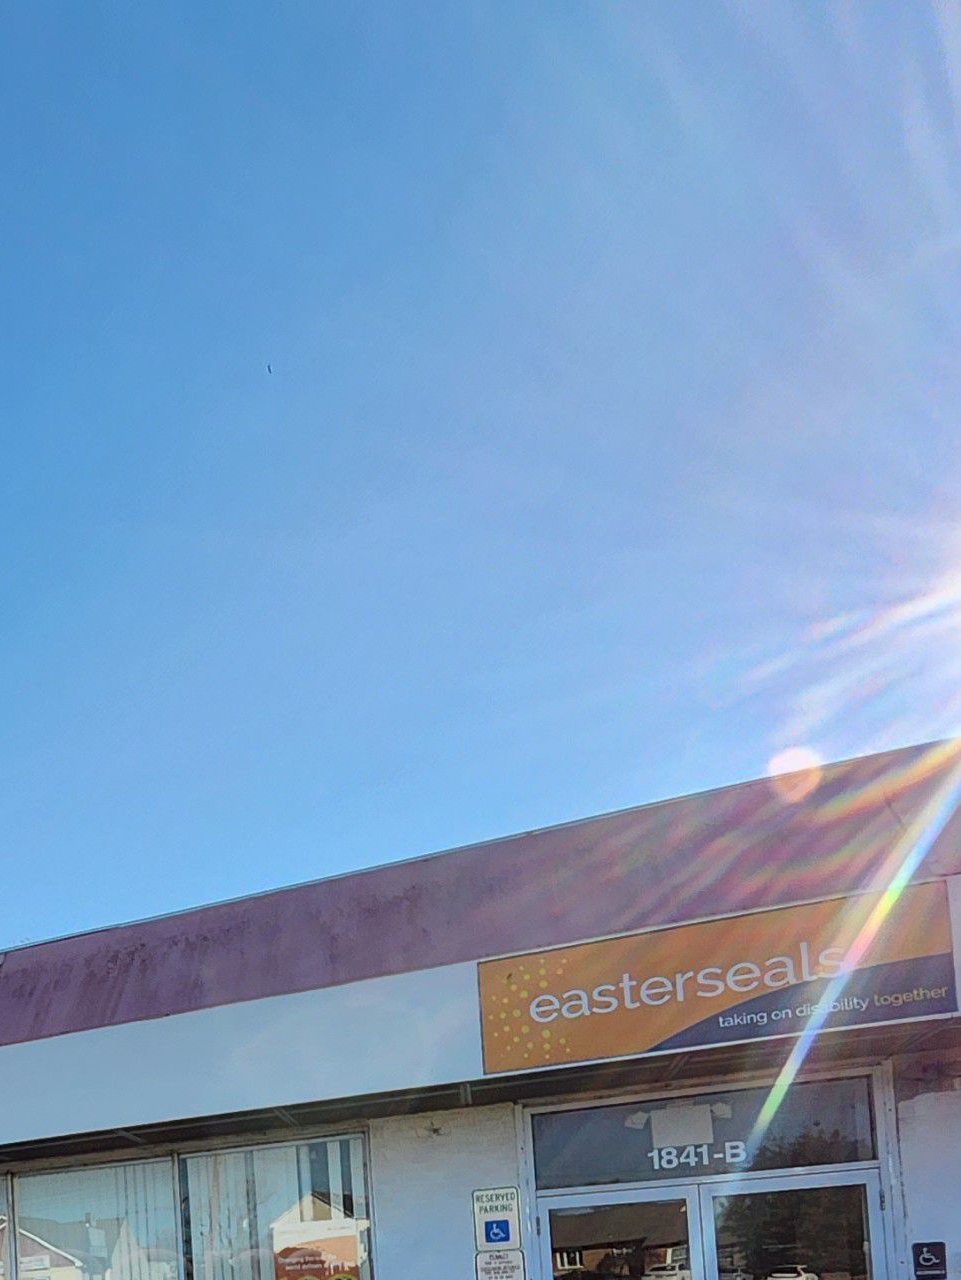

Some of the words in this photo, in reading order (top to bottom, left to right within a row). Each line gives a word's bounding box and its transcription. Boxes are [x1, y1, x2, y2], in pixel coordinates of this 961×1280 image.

[528, 942, 849, 1023] easterseals
[719, 1010, 767, 1027] taking
[771, 1008, 792, 1020] on
[795, 996, 870, 1016] disbility
[874, 986, 948, 1007] together
[647, 1141, 747, 1170] 1841-B
[475, 1192, 516, 1204] RESERVED
[478, 1203, 514, 1215] PARKING
